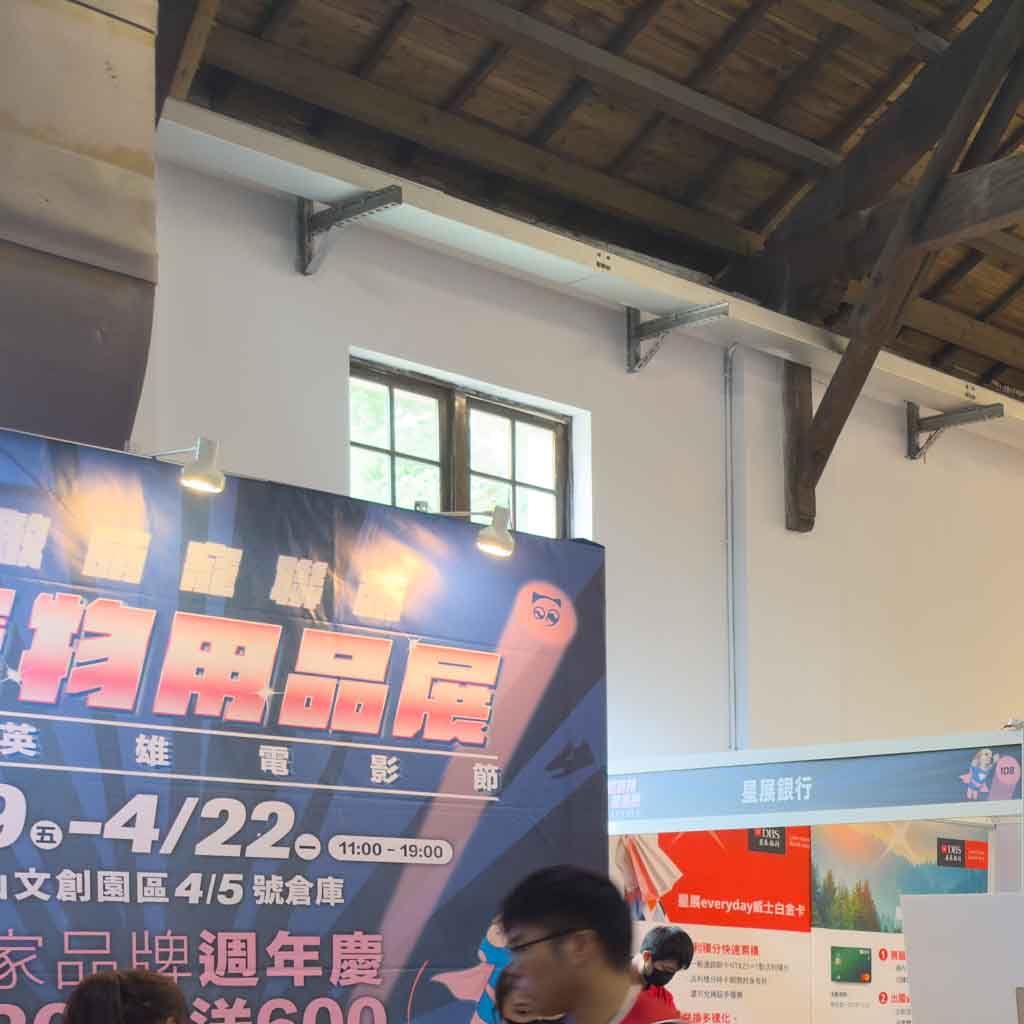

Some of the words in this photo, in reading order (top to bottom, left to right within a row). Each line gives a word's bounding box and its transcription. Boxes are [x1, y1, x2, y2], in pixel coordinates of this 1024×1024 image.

[0, 588, 501, 747] 物用品展
[741, 775, 812, 804] 星展銀行
[337, 841, 383, 857] 11:00
[400, 842, 444, 860] 19:00
